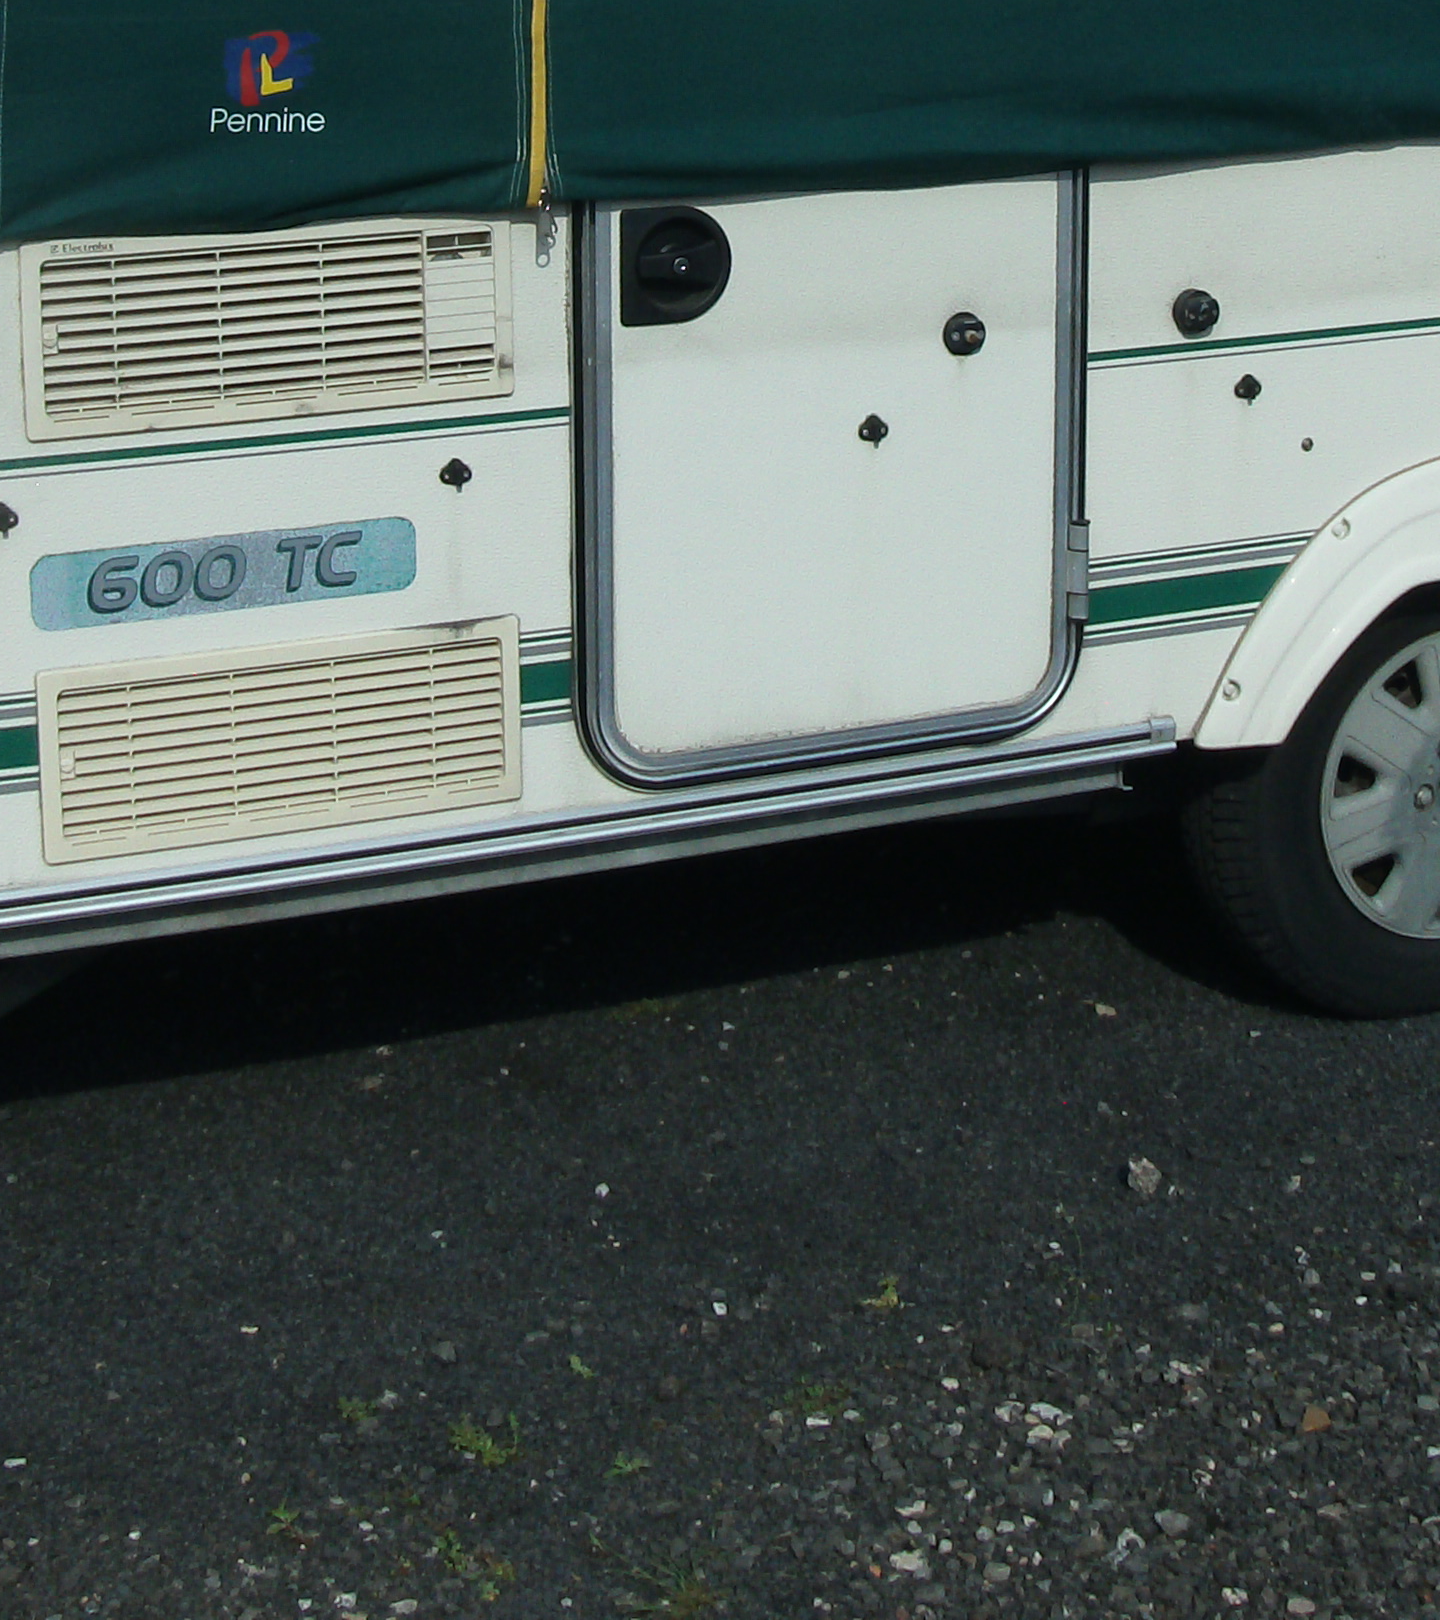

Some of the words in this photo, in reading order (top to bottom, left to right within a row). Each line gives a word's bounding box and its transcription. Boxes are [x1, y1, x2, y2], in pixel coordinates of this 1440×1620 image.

[209, 107, 326, 133] Pennine
[86, 545, 248, 615] 600
[276, 530, 363, 593] TC
